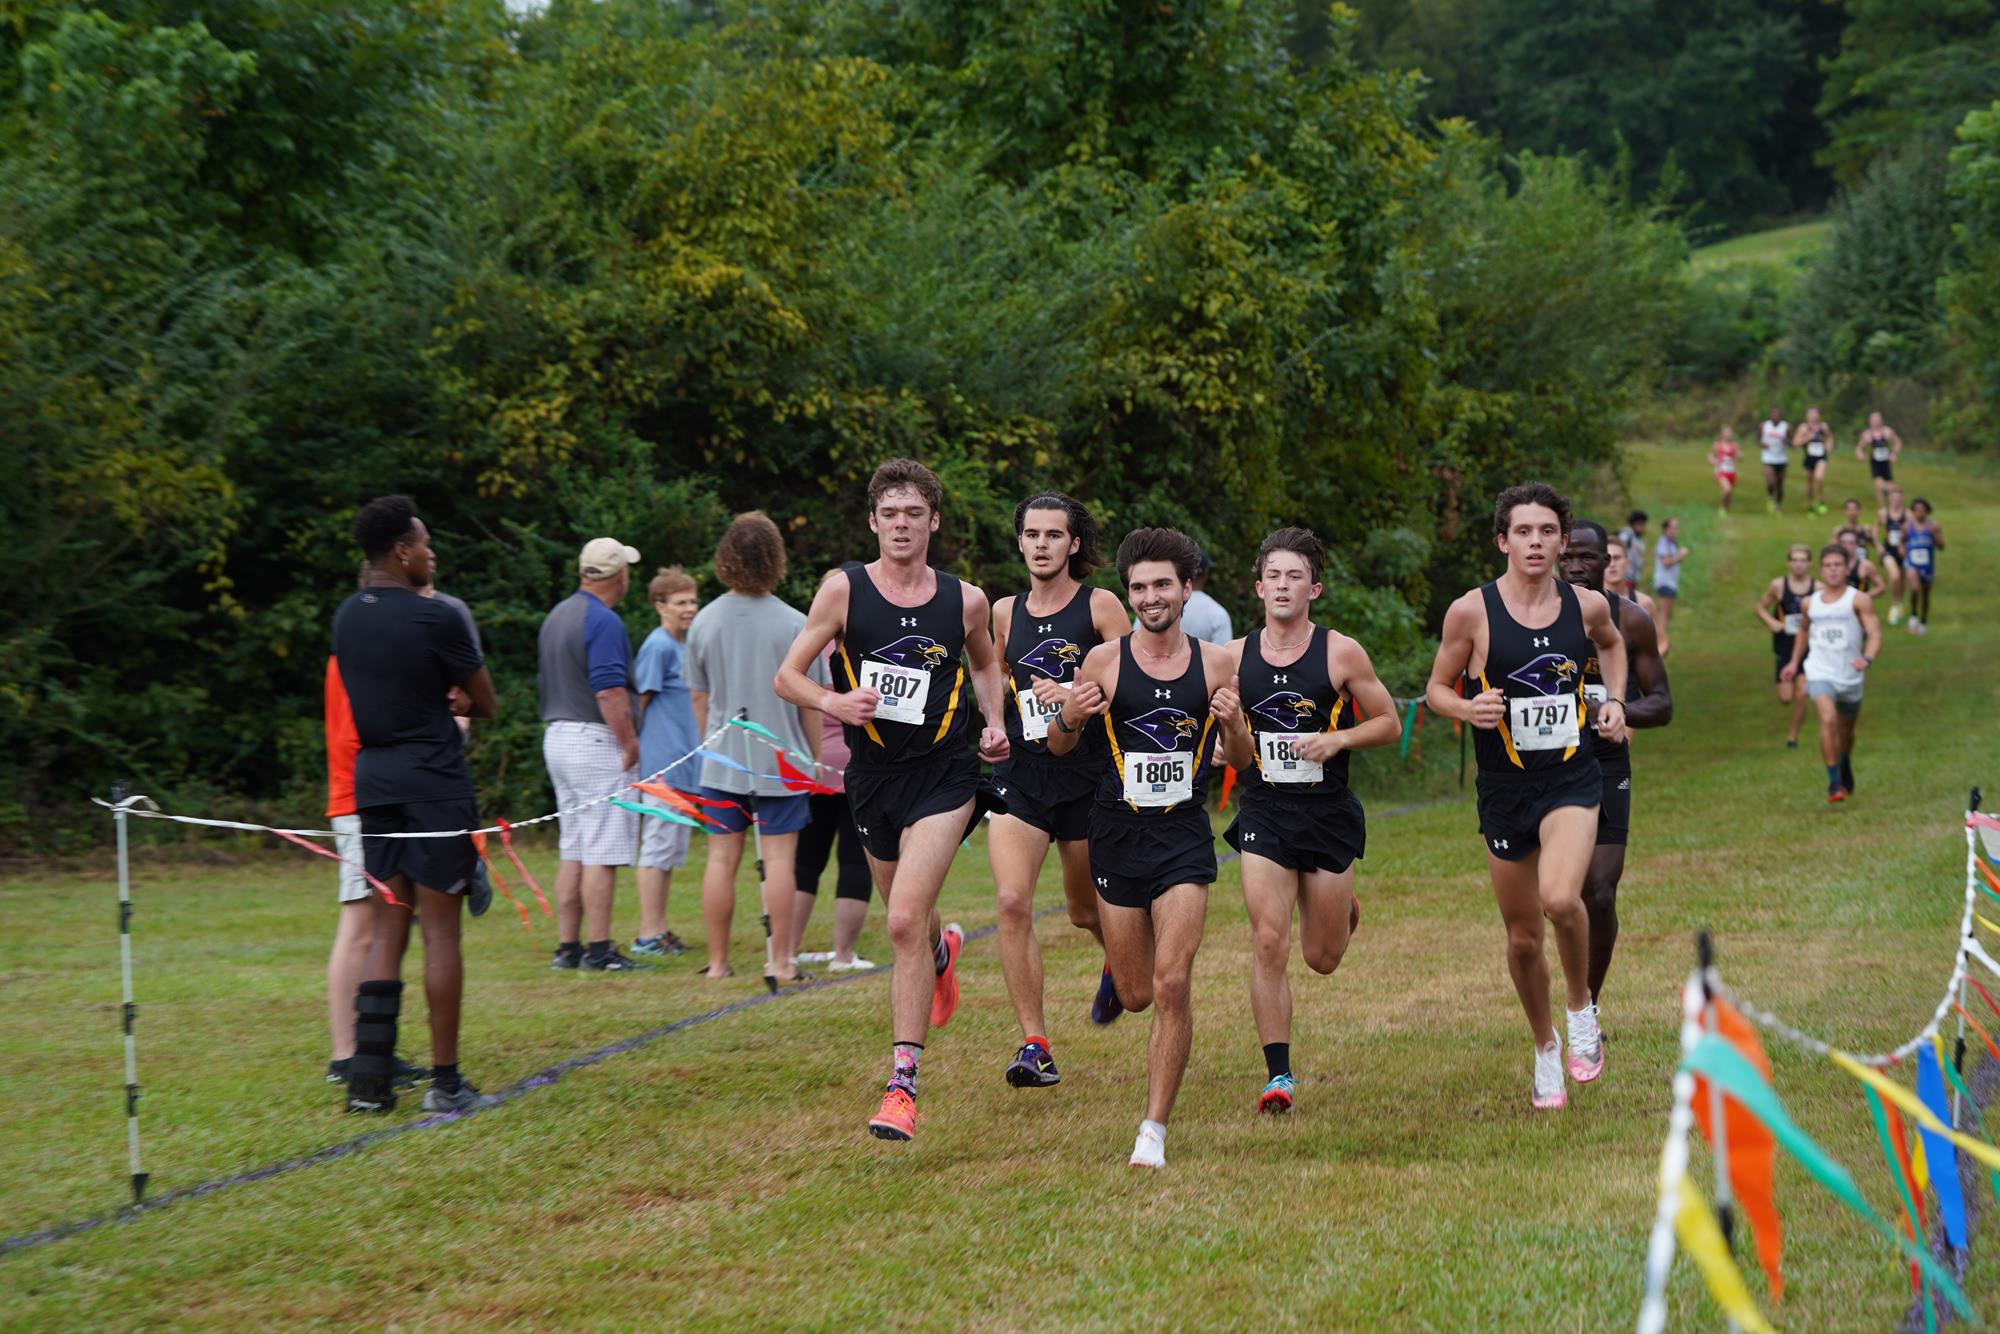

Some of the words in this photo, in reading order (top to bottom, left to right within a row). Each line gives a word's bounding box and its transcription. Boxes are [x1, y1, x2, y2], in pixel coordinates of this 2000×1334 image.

[869, 672, 921, 699] 1807
[1026, 697, 1064, 718] 180
[1520, 704, 1569, 727] 1797
[1266, 740, 1305, 761] 180
[1133, 760, 1185, 783] 1805
